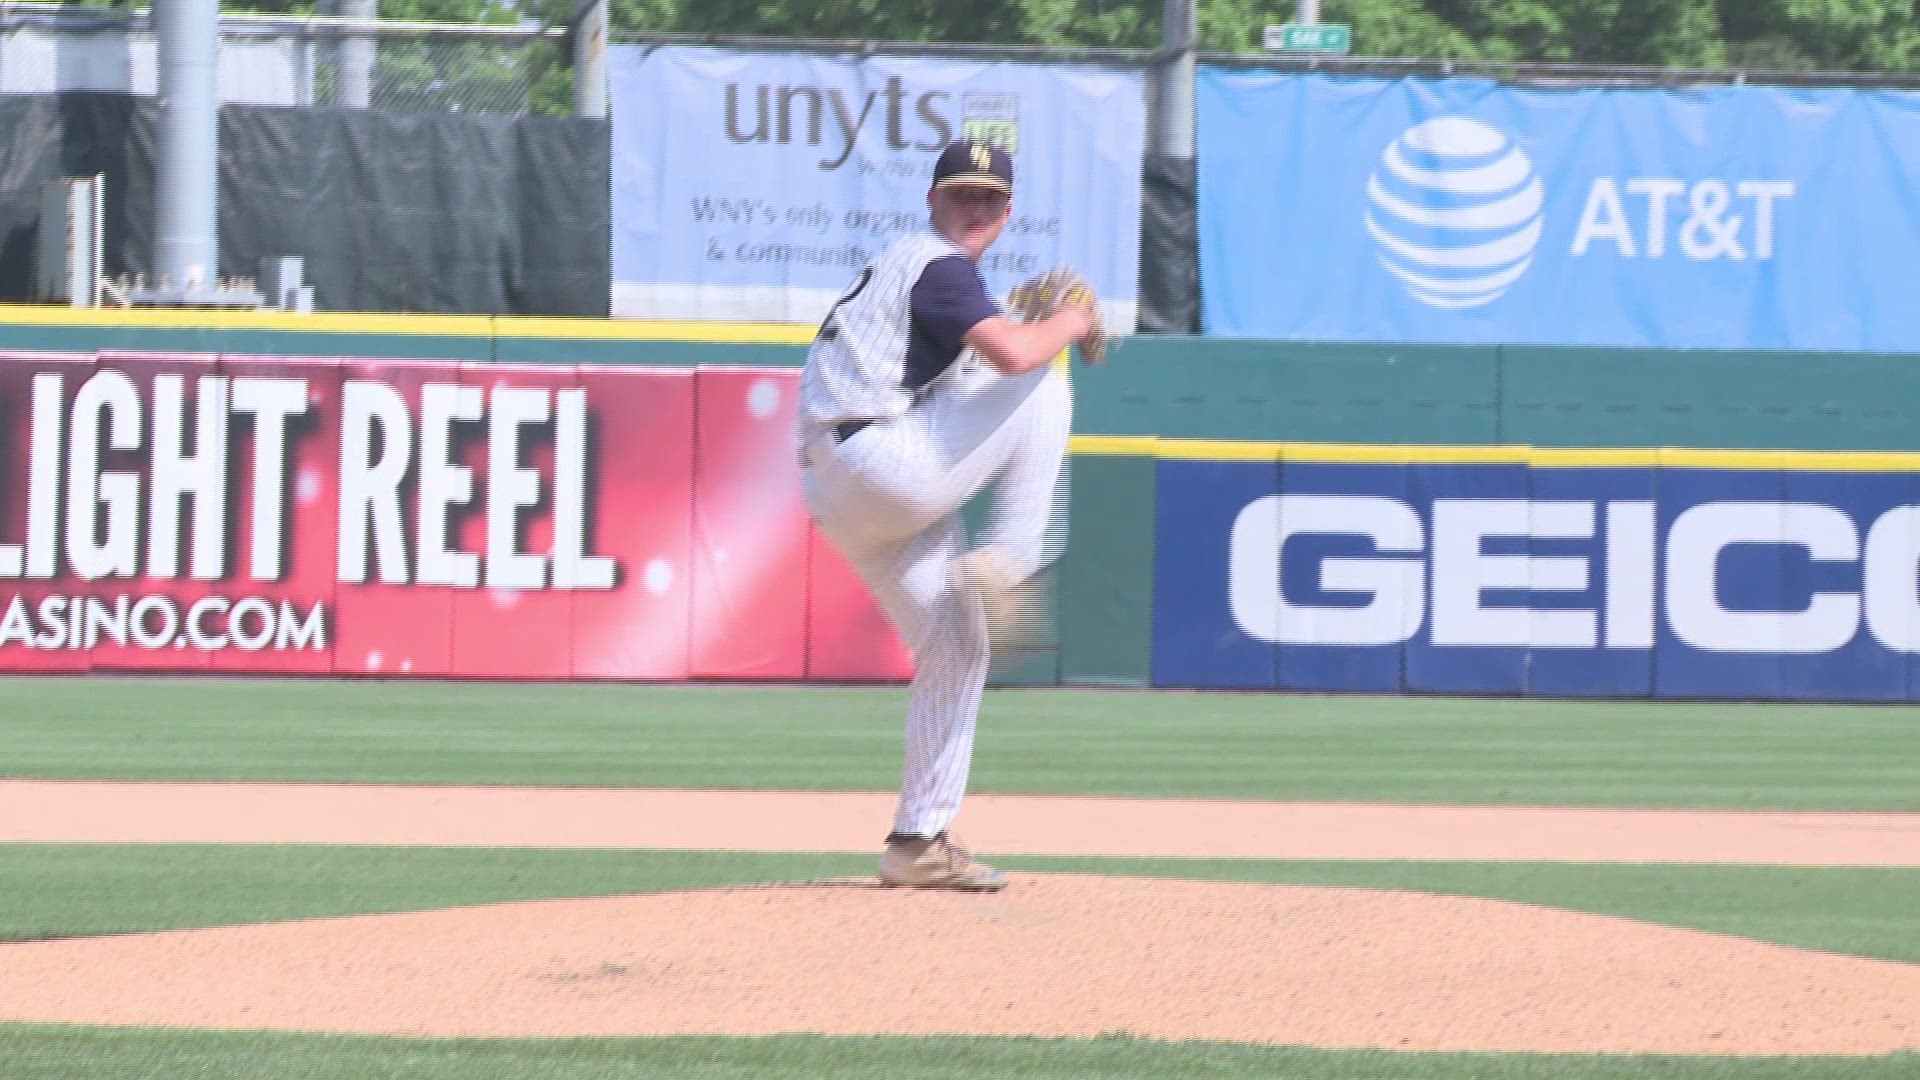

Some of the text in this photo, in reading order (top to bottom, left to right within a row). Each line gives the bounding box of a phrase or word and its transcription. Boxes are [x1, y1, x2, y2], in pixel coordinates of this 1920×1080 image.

[723, 75, 953, 170] unyts
[690, 196, 1059, 236] WNY's only organ ssue
[705, 237, 728, 260] &
[735, 242, 872, 274] community
[1570, 176, 1794, 260] AT&T
[336, 378, 618, 590] REEL
